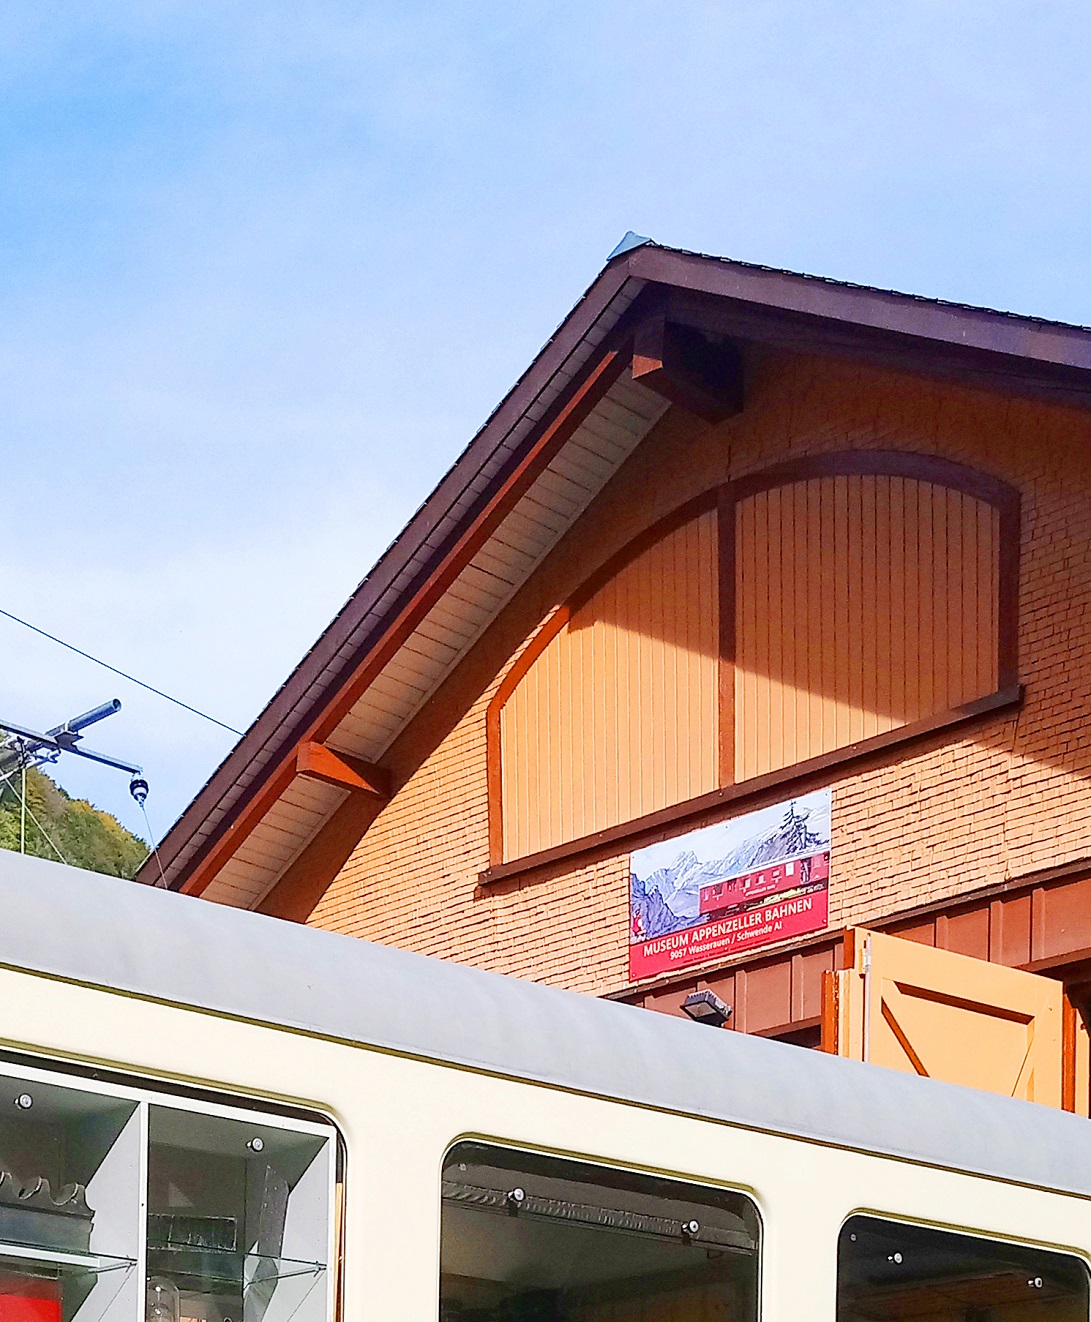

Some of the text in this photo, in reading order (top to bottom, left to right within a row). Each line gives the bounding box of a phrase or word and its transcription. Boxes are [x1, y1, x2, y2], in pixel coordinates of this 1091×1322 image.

[643, 934, 689, 957] MUSEUM
[691, 912, 763, 942] APPENZELLER
[765, 898, 812, 923] BAHNEN
[669, 948, 687, 961] 9057
[688, 938, 730, 955] Wasserauen
[736, 925, 773, 941] Schwende
